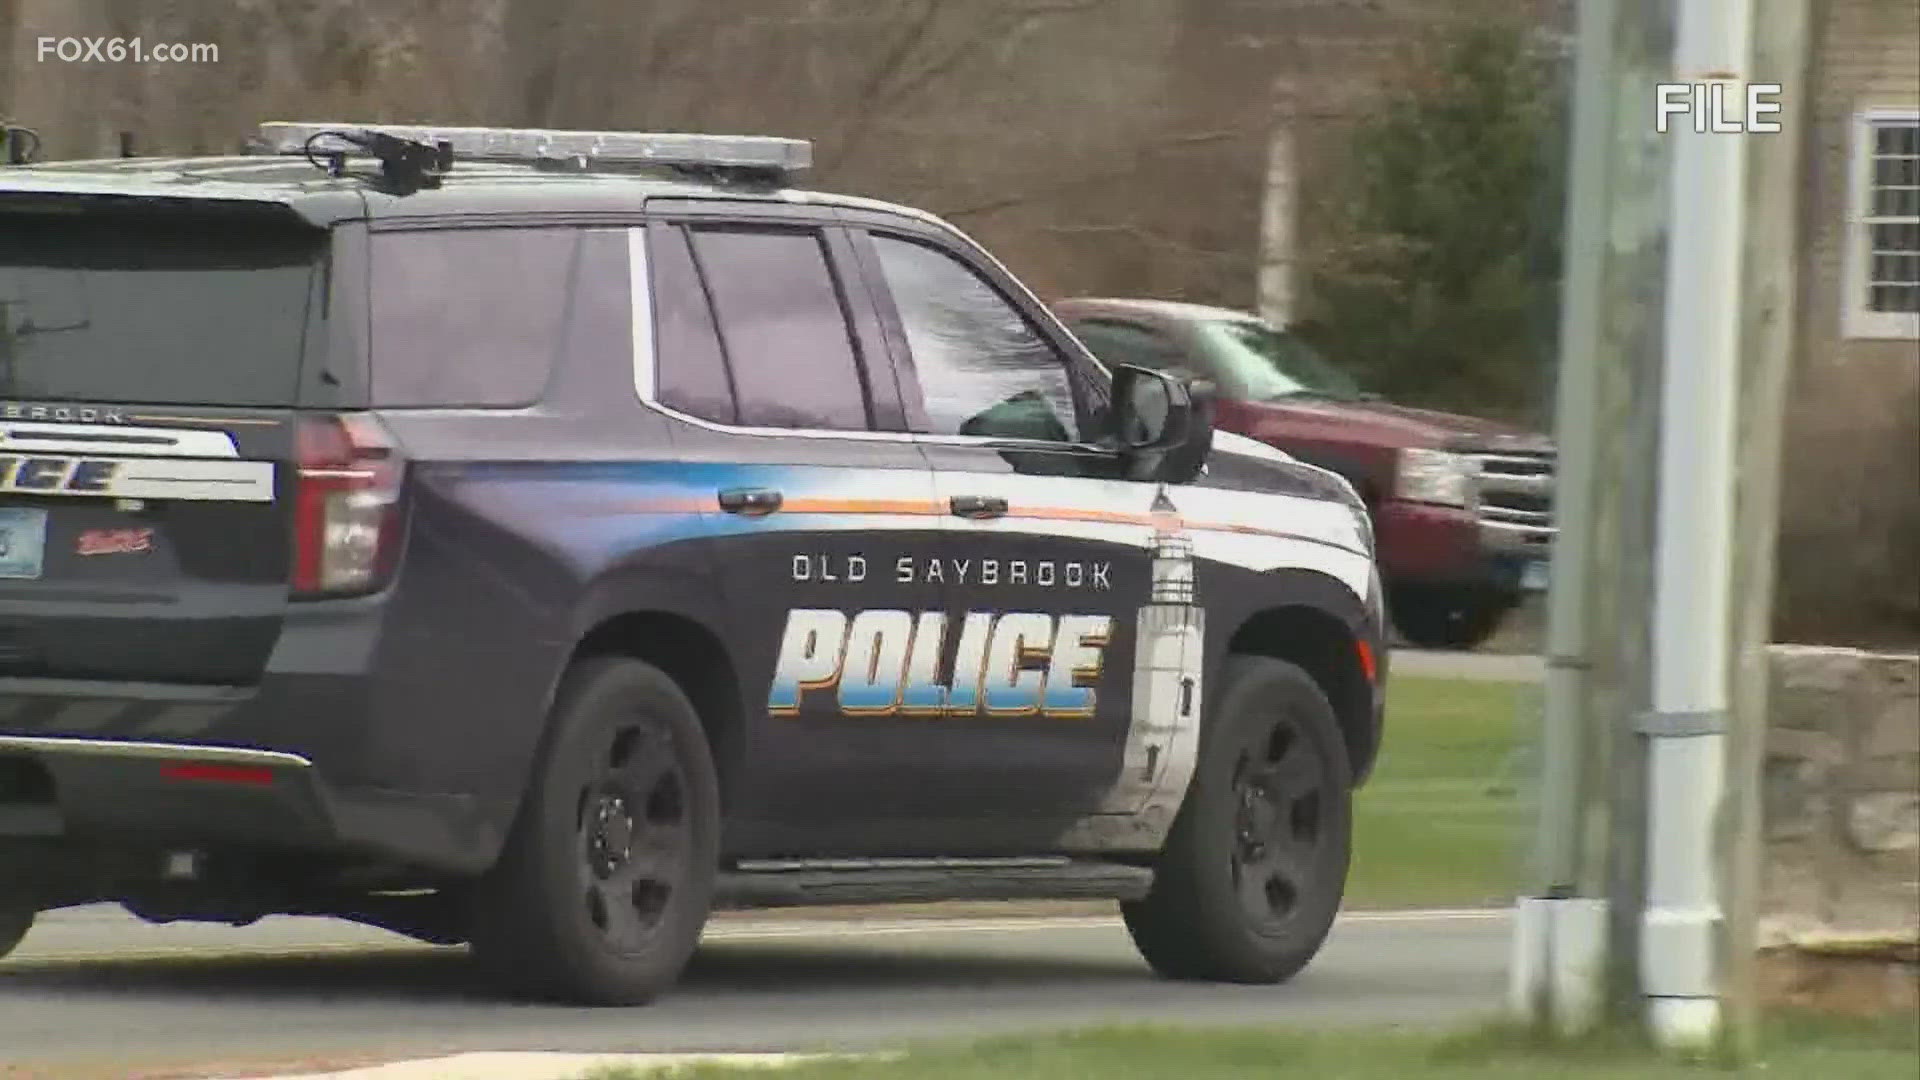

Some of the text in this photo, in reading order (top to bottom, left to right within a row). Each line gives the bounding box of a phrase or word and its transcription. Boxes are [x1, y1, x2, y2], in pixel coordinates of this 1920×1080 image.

[793, 555, 1112, 588] OLD SAYBROOK
[768, 608, 1114, 717] POLICE
